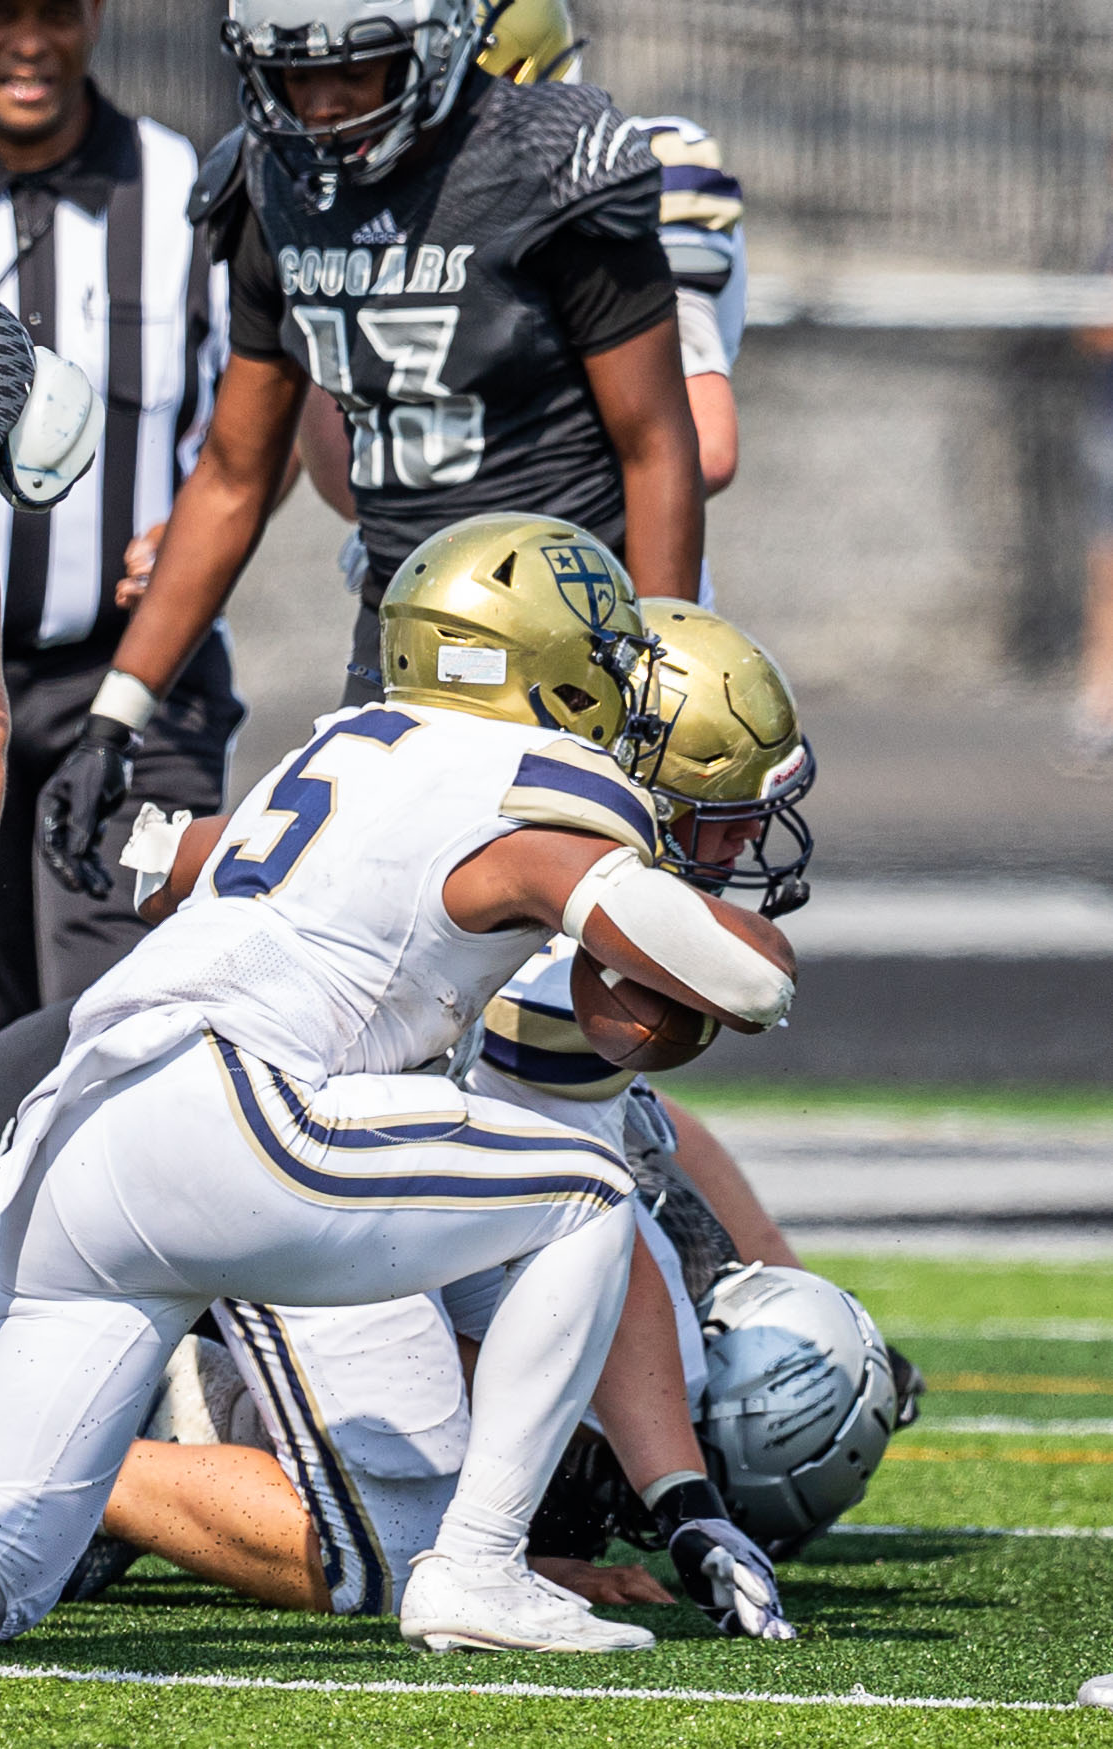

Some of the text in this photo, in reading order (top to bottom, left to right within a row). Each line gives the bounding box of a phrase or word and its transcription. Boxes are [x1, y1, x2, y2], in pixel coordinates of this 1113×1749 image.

[278, 244, 475, 297] COUGARS
[291, 305, 486, 490] 13
[210, 704, 430, 901] 5
